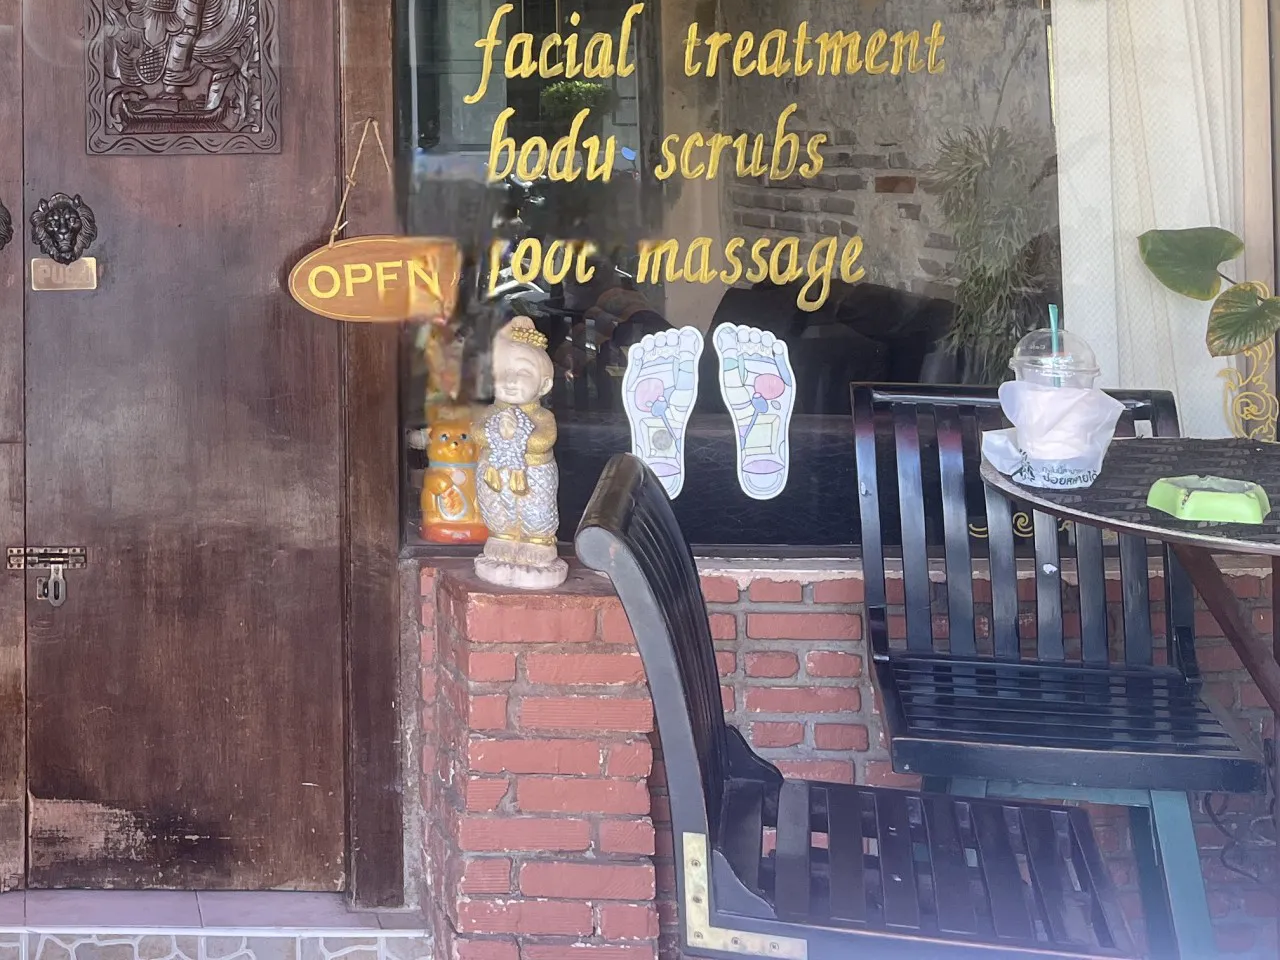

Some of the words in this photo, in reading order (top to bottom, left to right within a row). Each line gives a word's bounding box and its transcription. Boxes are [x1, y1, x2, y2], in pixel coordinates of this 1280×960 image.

[463, 3, 644, 104] facial
[684, 19, 947, 78] treatment
[655, 103, 827, 181] scrubs
[637, 236, 865, 312] massage
